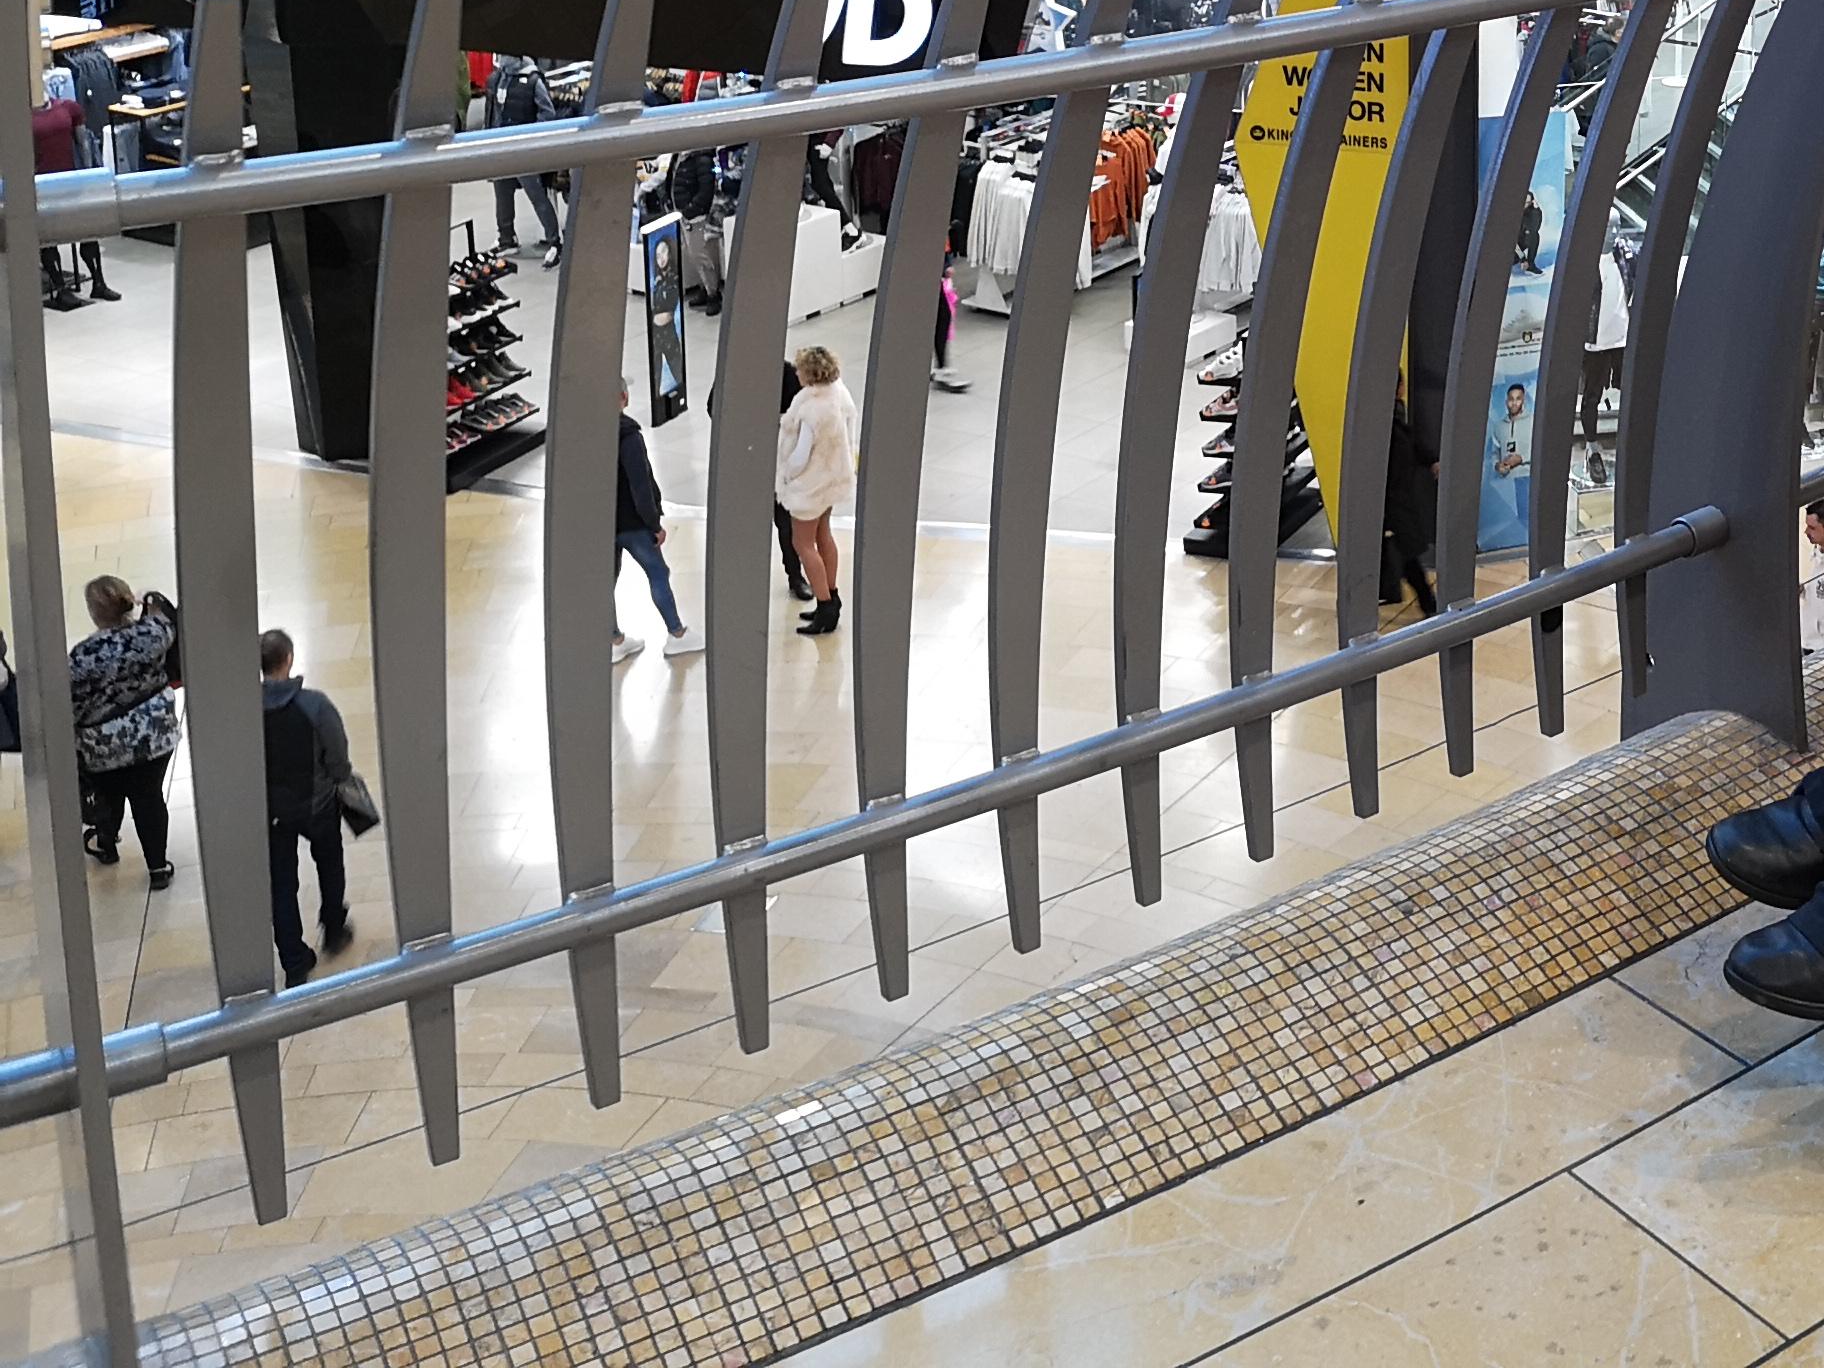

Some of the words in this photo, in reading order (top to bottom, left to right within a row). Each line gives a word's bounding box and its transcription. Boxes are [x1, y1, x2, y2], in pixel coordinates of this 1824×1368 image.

[1282, 65, 1384, 93] WEN
[1289, 96, 1385, 122] JOR
[1267, 128, 1294, 141] KIN
[1341, 134, 1388, 149] AINERS
